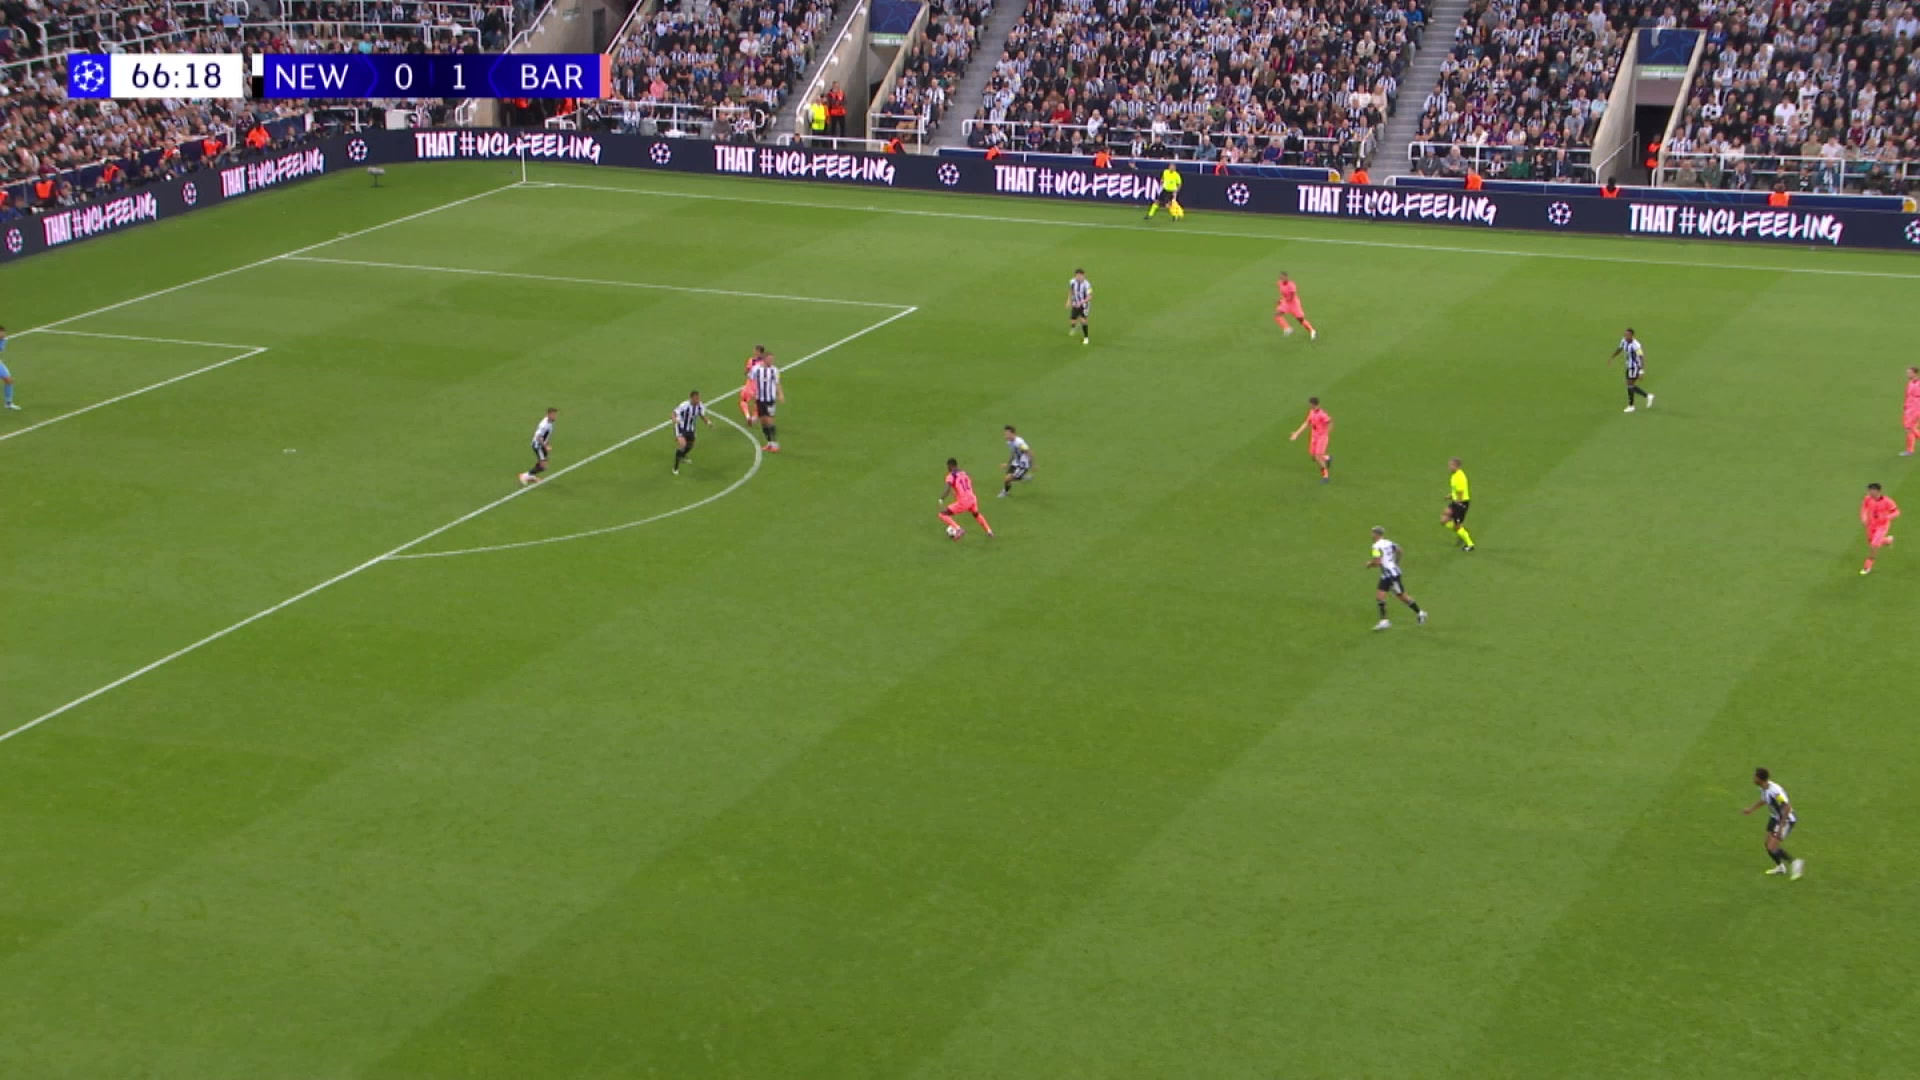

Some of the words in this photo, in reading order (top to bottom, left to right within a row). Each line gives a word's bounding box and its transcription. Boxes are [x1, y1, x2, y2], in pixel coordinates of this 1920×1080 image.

[415, 131, 457, 158] THAT
[221, 167, 246, 197] THAT
[715, 145, 757, 172] THAT
[760, 149, 895, 186] #UCLFEELING
[995, 165, 1037, 194] THAT
[1038, 168, 1163, 201] #UCLFEELIN
[1298, 185, 1342, 213] THAT
[43, 211, 72, 246] THAT
[1629, 204, 1678, 233] THAT
[1680, 207, 1843, 245] #UCLFEELING
